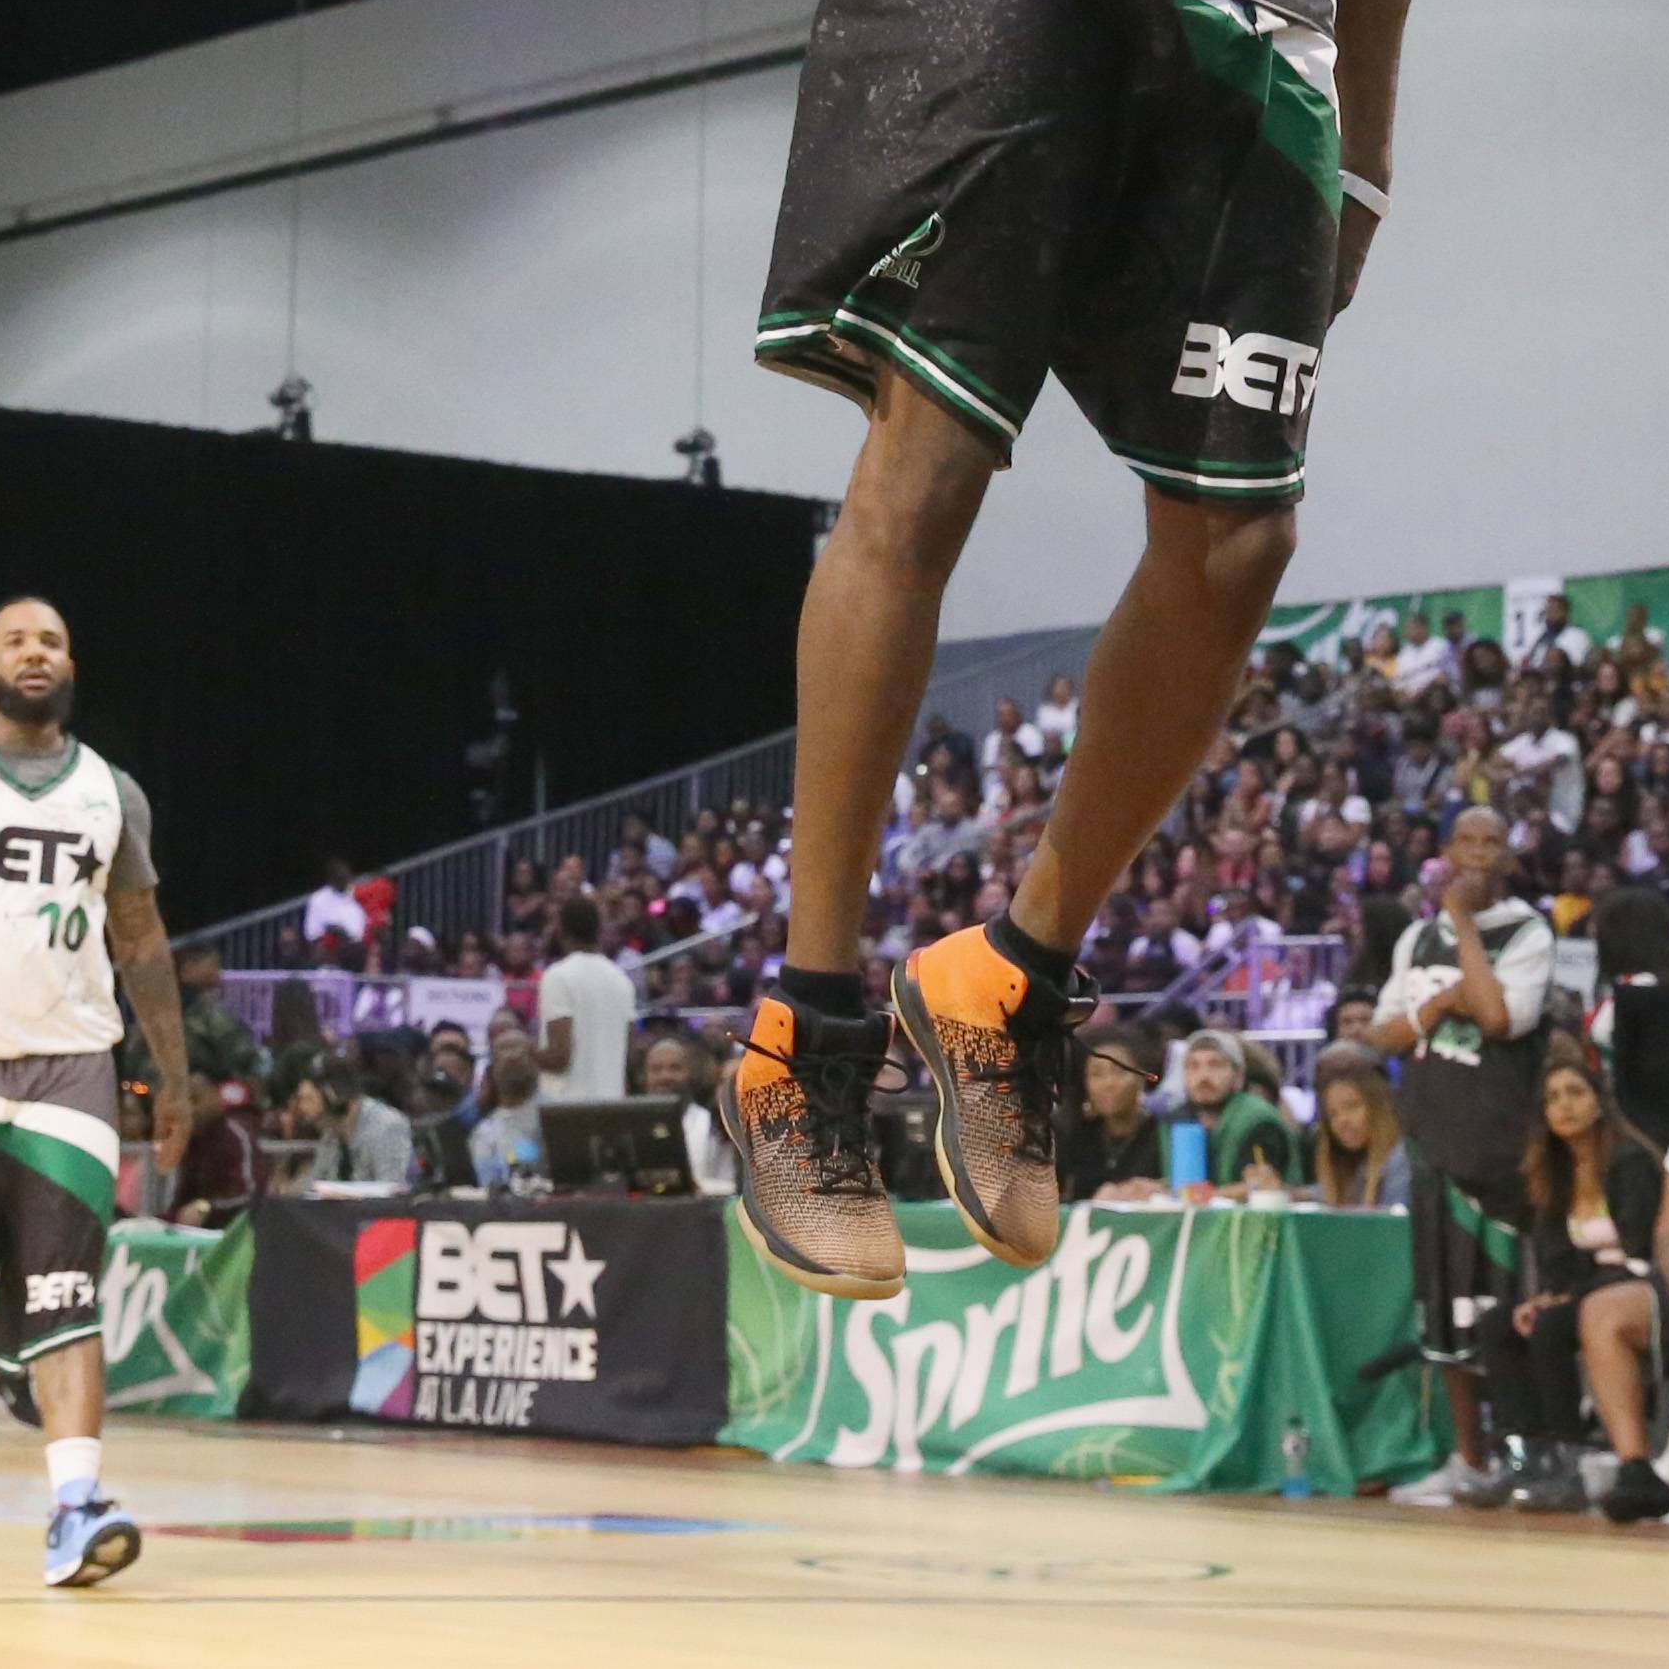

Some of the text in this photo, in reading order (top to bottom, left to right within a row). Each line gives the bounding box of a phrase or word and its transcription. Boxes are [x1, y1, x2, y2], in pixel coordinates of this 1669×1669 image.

[1171, 322, 1320, 416] BET
[38, 902, 90, 952] 10
[416, 1220, 567, 1324] BET
[416, 1321, 598, 1381] EXPERIENCE
[826, 1199, 1155, 1472] Sprite
